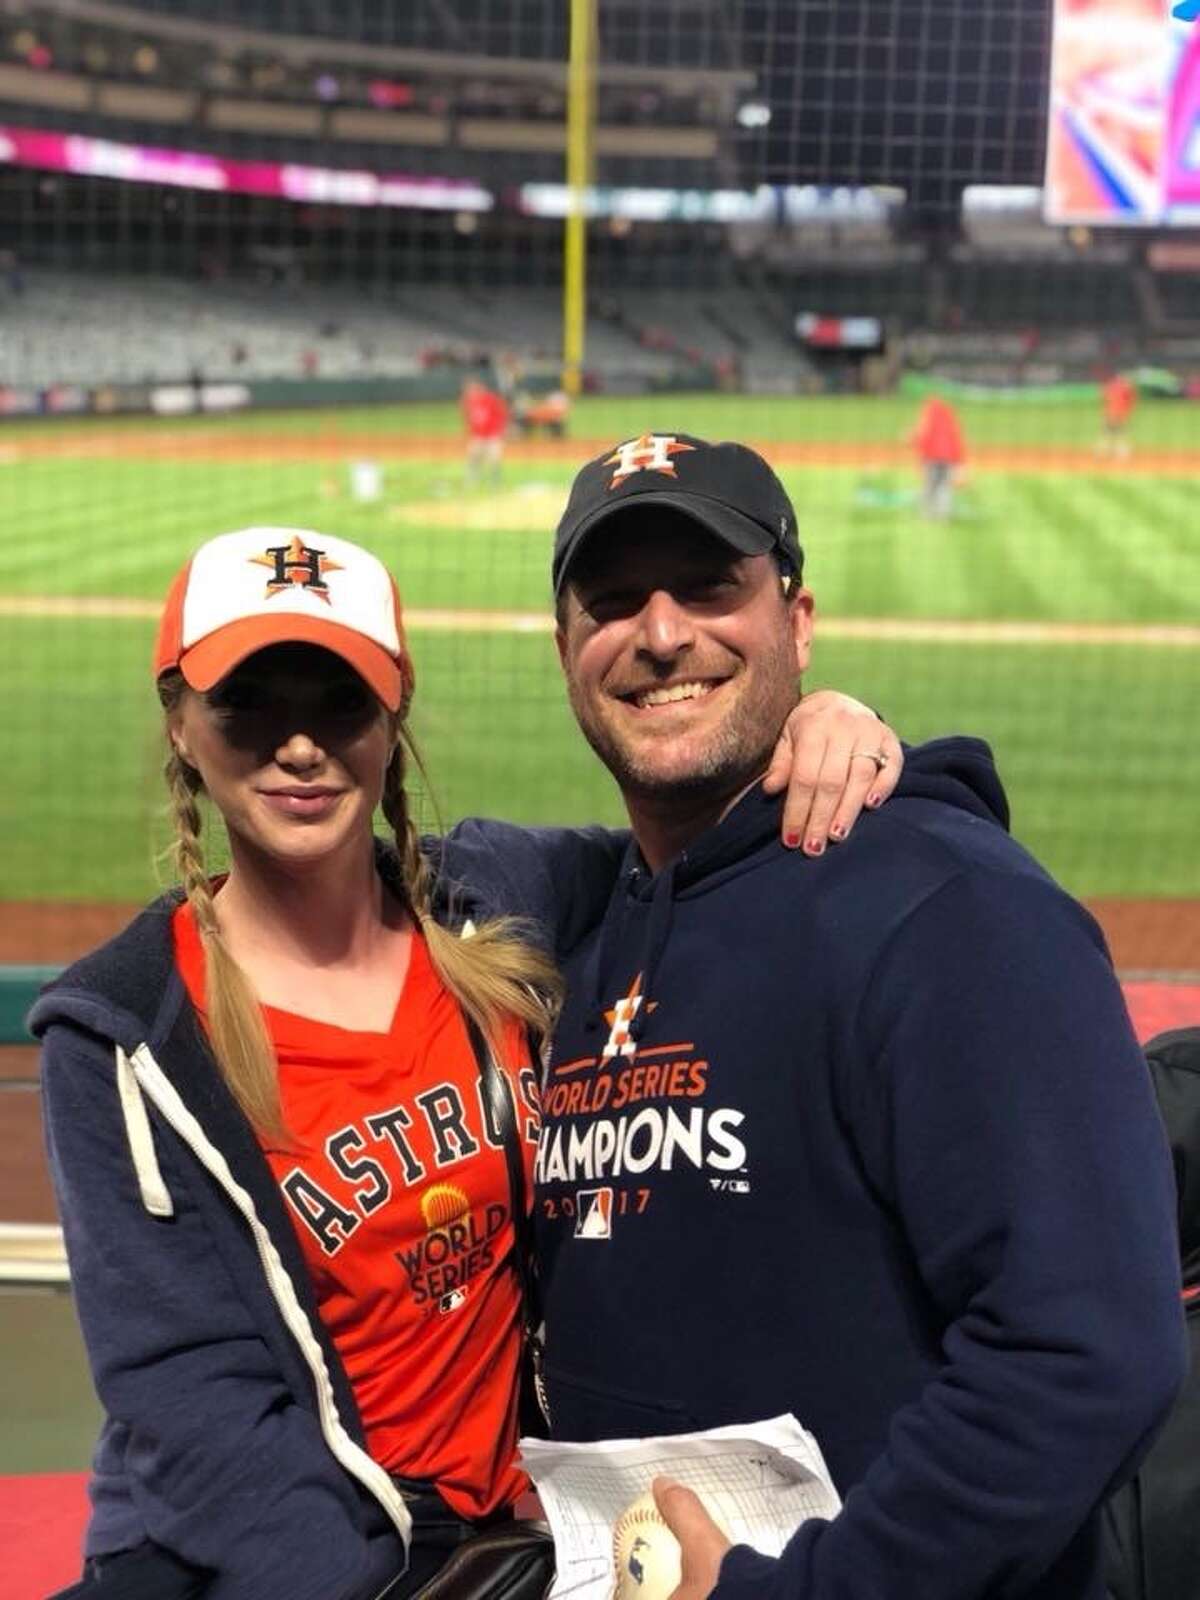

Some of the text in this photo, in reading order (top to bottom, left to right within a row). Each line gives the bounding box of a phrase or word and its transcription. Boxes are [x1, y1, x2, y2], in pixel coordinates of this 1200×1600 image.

[613, 436, 676, 477] H
[265, 545, 328, 590] H
[612, 1060, 709, 1110] SERIES
[533, 1106, 747, 1184] HAMPIONS
[394, 1203, 507, 1277] WORLD
[408, 1243, 495, 1305] SERIES
